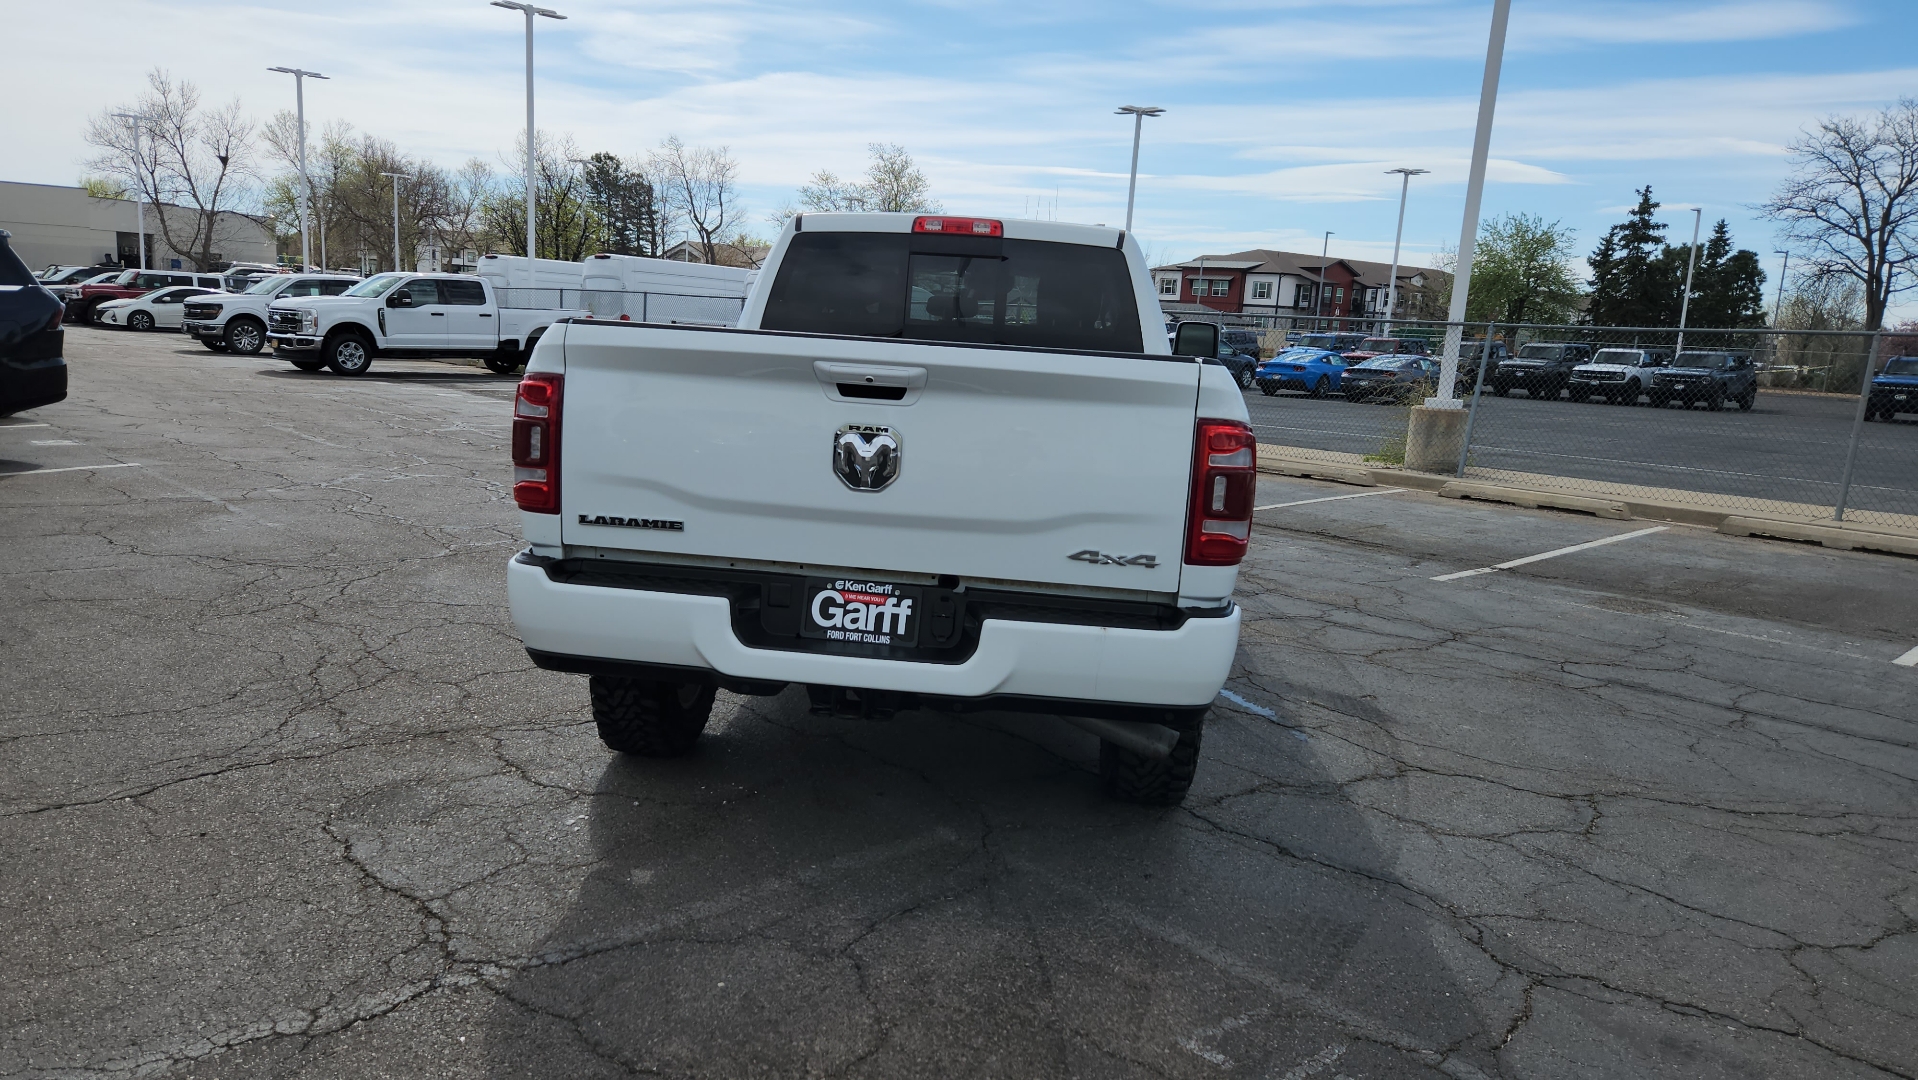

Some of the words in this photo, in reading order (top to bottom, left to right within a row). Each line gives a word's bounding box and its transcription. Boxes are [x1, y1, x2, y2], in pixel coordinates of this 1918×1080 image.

[849, 425, 889, 433] RAM
[578, 514, 685, 531] LARAMIE
[845, 580, 866, 592] Ken
[866, 583, 893, 595] Garff
[811, 589, 913, 635] Garff
[827, 630, 845, 640] FORD
[845, 632, 863, 642] FORT
[863, 633, 890, 645] COLLINS
